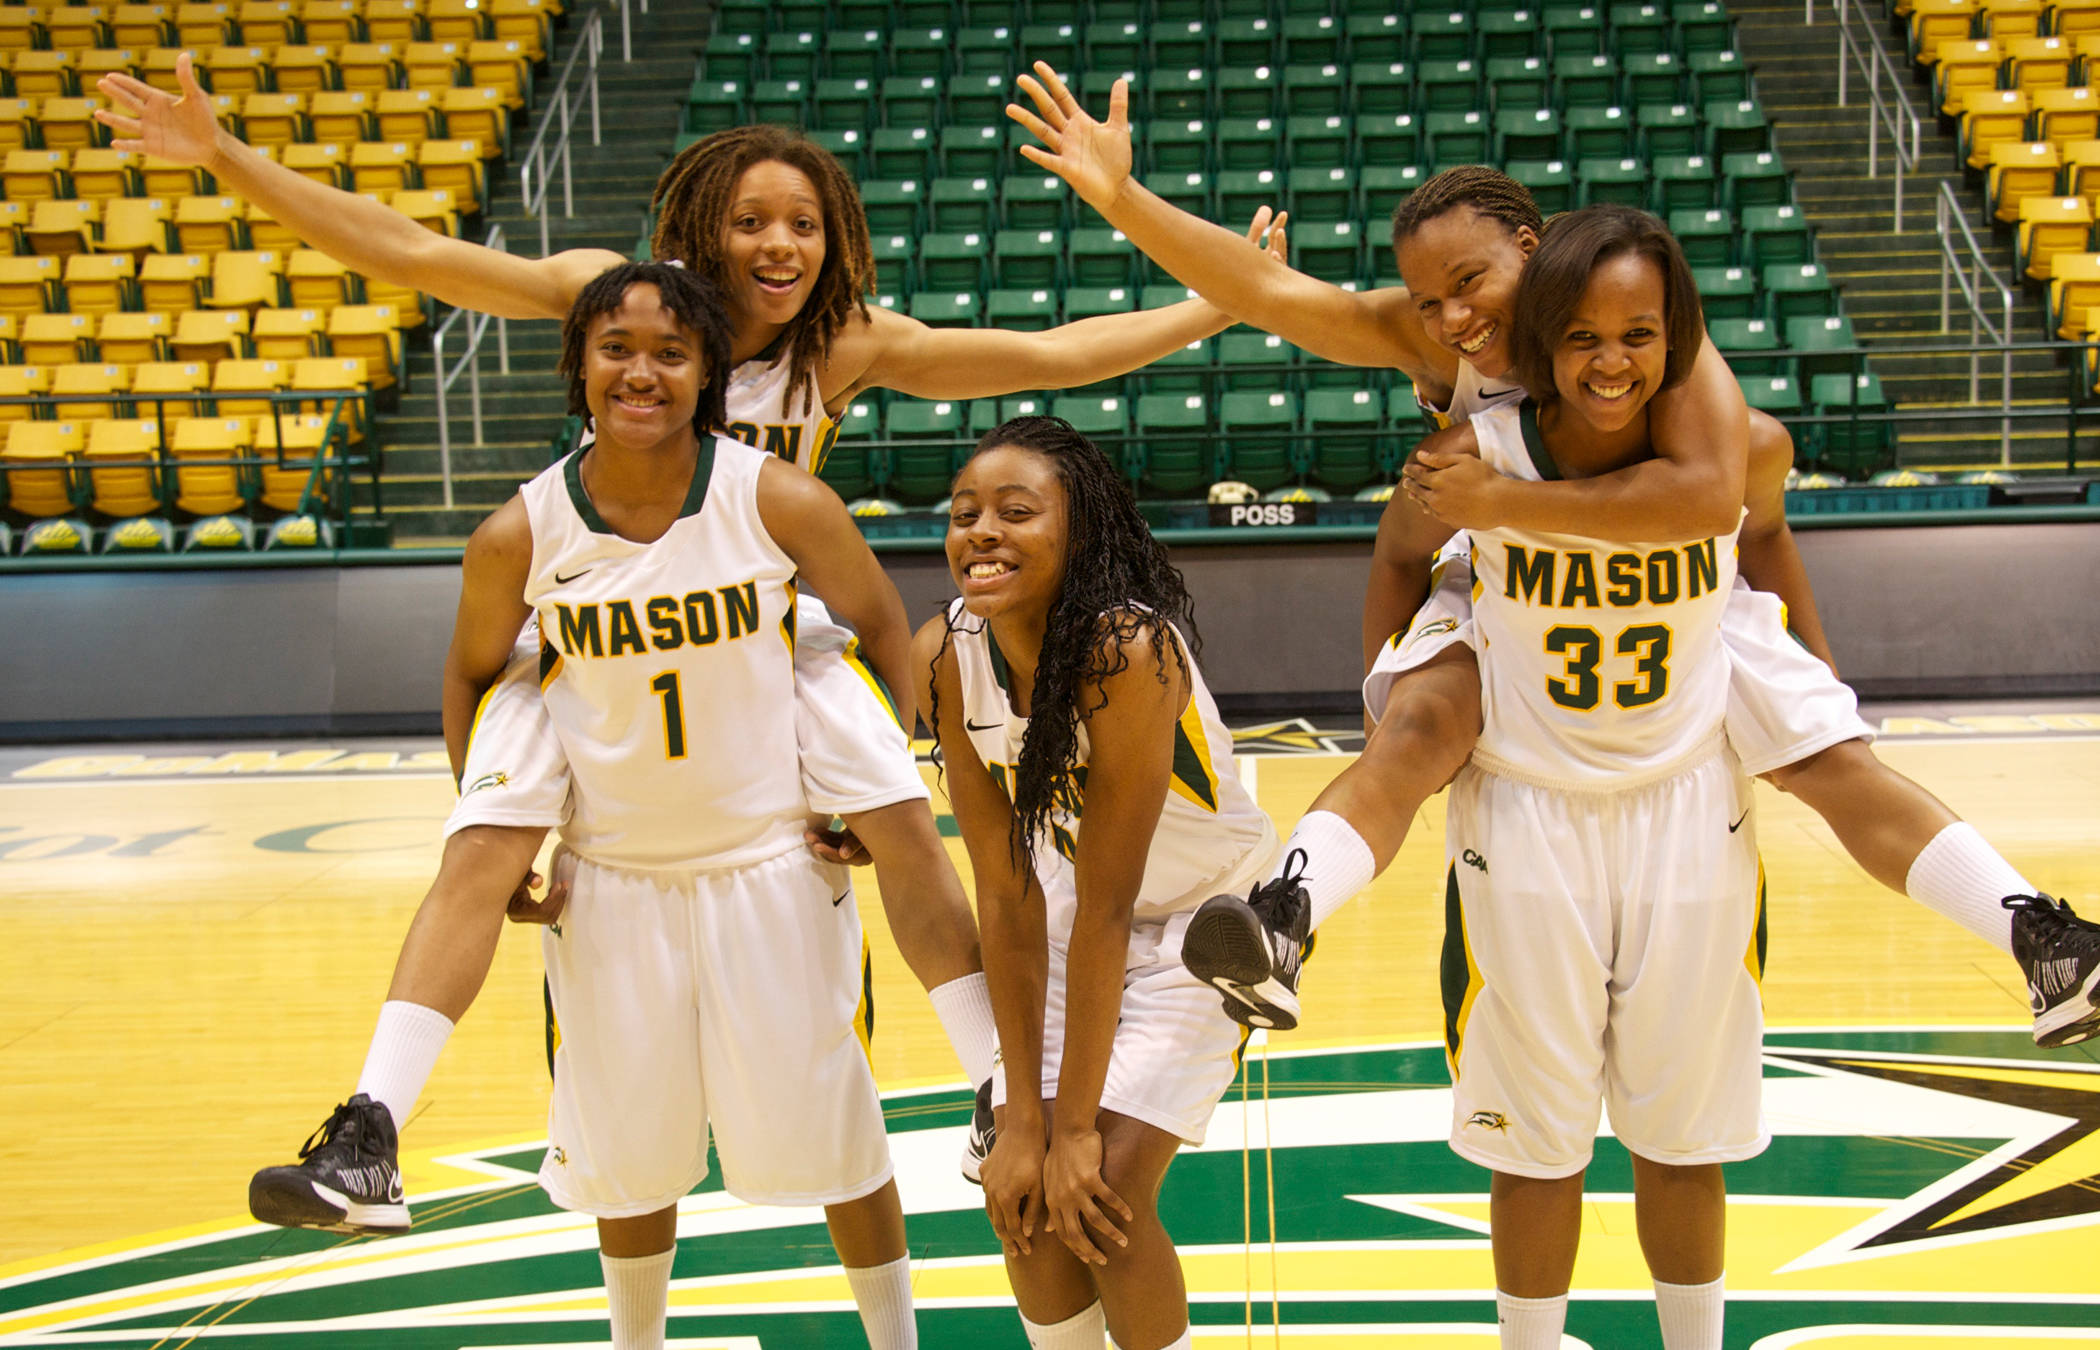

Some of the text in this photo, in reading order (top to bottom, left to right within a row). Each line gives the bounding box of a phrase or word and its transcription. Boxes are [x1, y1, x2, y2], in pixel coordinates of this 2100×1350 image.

[1231, 504, 1295, 526] POSS
[1502, 536, 1719, 608] MASON
[553, 578, 760, 660] MASON
[1543, 621, 1674, 713] 33
[649, 669, 688, 761] 1
